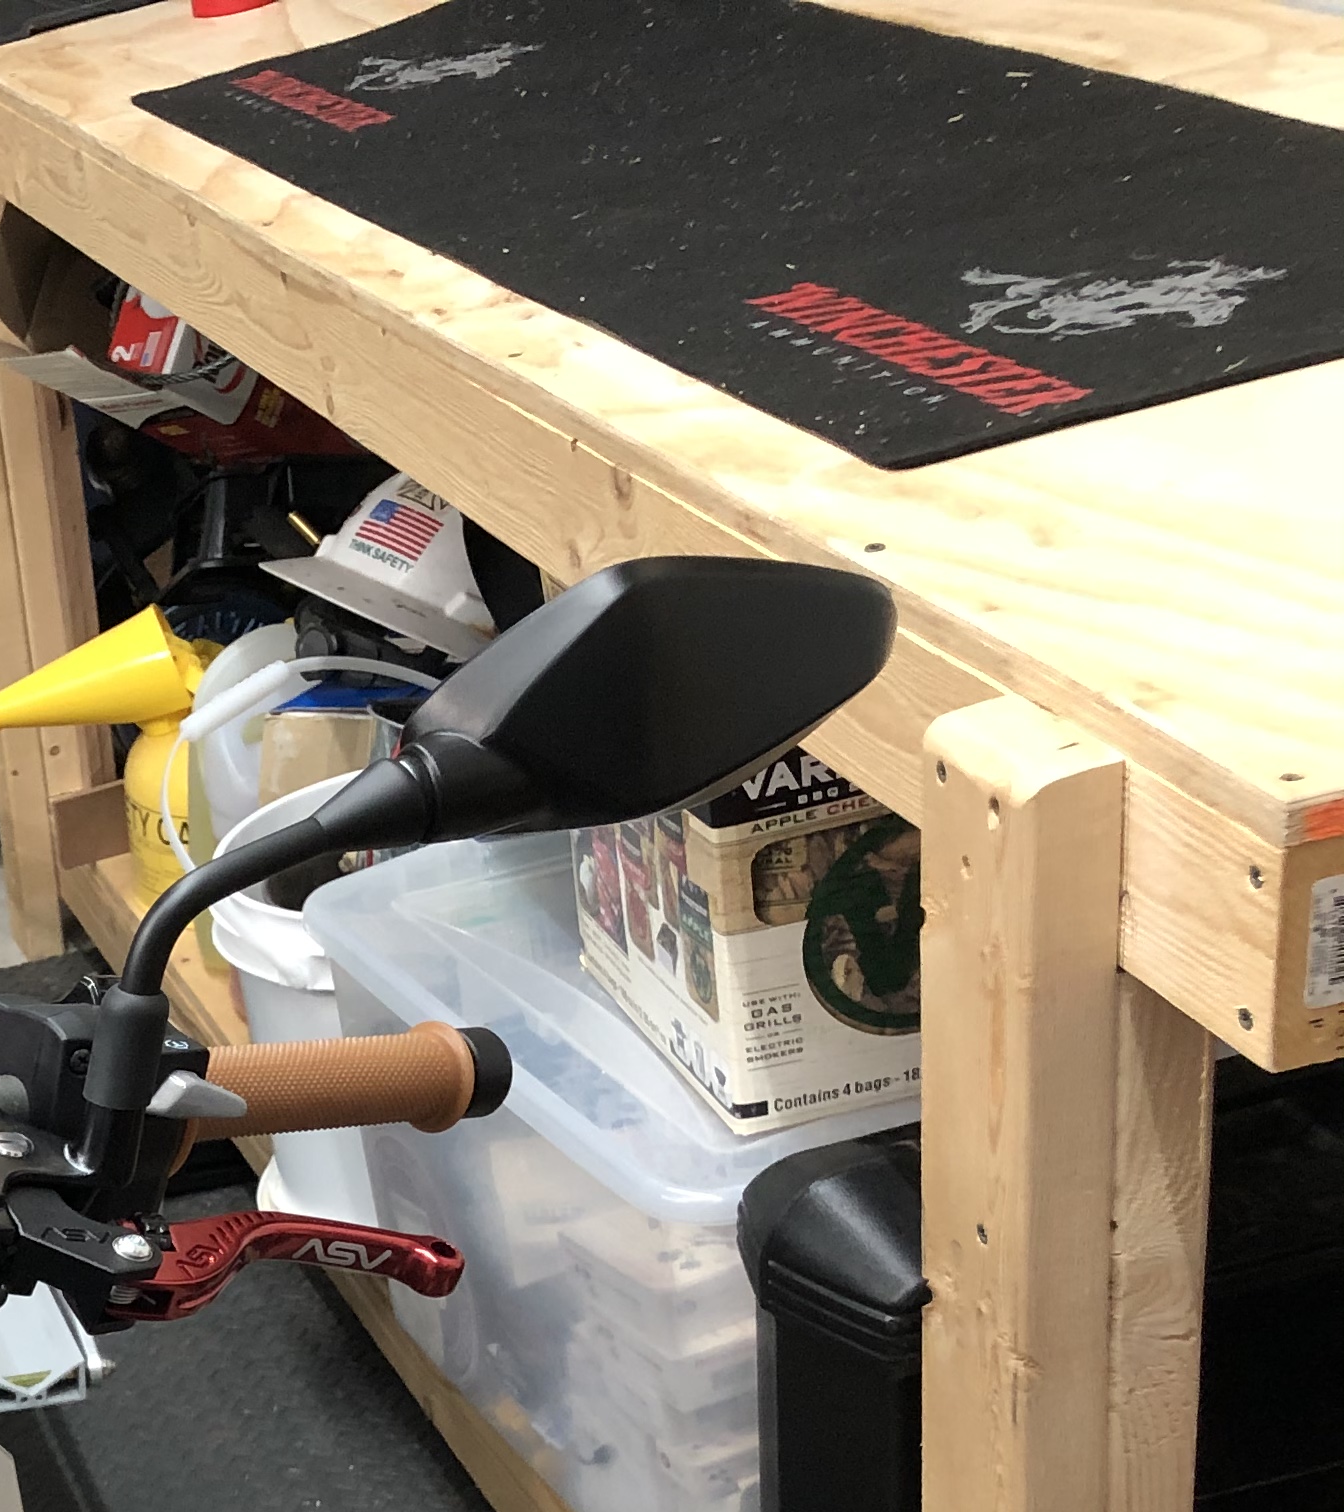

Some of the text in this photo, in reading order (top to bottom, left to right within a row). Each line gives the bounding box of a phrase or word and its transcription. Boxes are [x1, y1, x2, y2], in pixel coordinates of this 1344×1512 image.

[745, 282, 1094, 414] WINCHESTER
[747, 320, 949, 405] AMMUNITION
[349, 538, 414, 574] THINK SAFETY
[751, 795, 880, 835] APPLE CHE
[743, 1013, 802, 1032] GRILLS
[750, 1003, 792, 1019] GAS
[744, 1036, 804, 1054] ELECTRIC
[746, 1046, 804, 1063] SMOKERS
[774, 1087, 839, 1112] Contains
[842, 1083, 851, 1096] 4
[855, 1076, 891, 1094] bags
[292, 1238, 393, 1271] ASV
